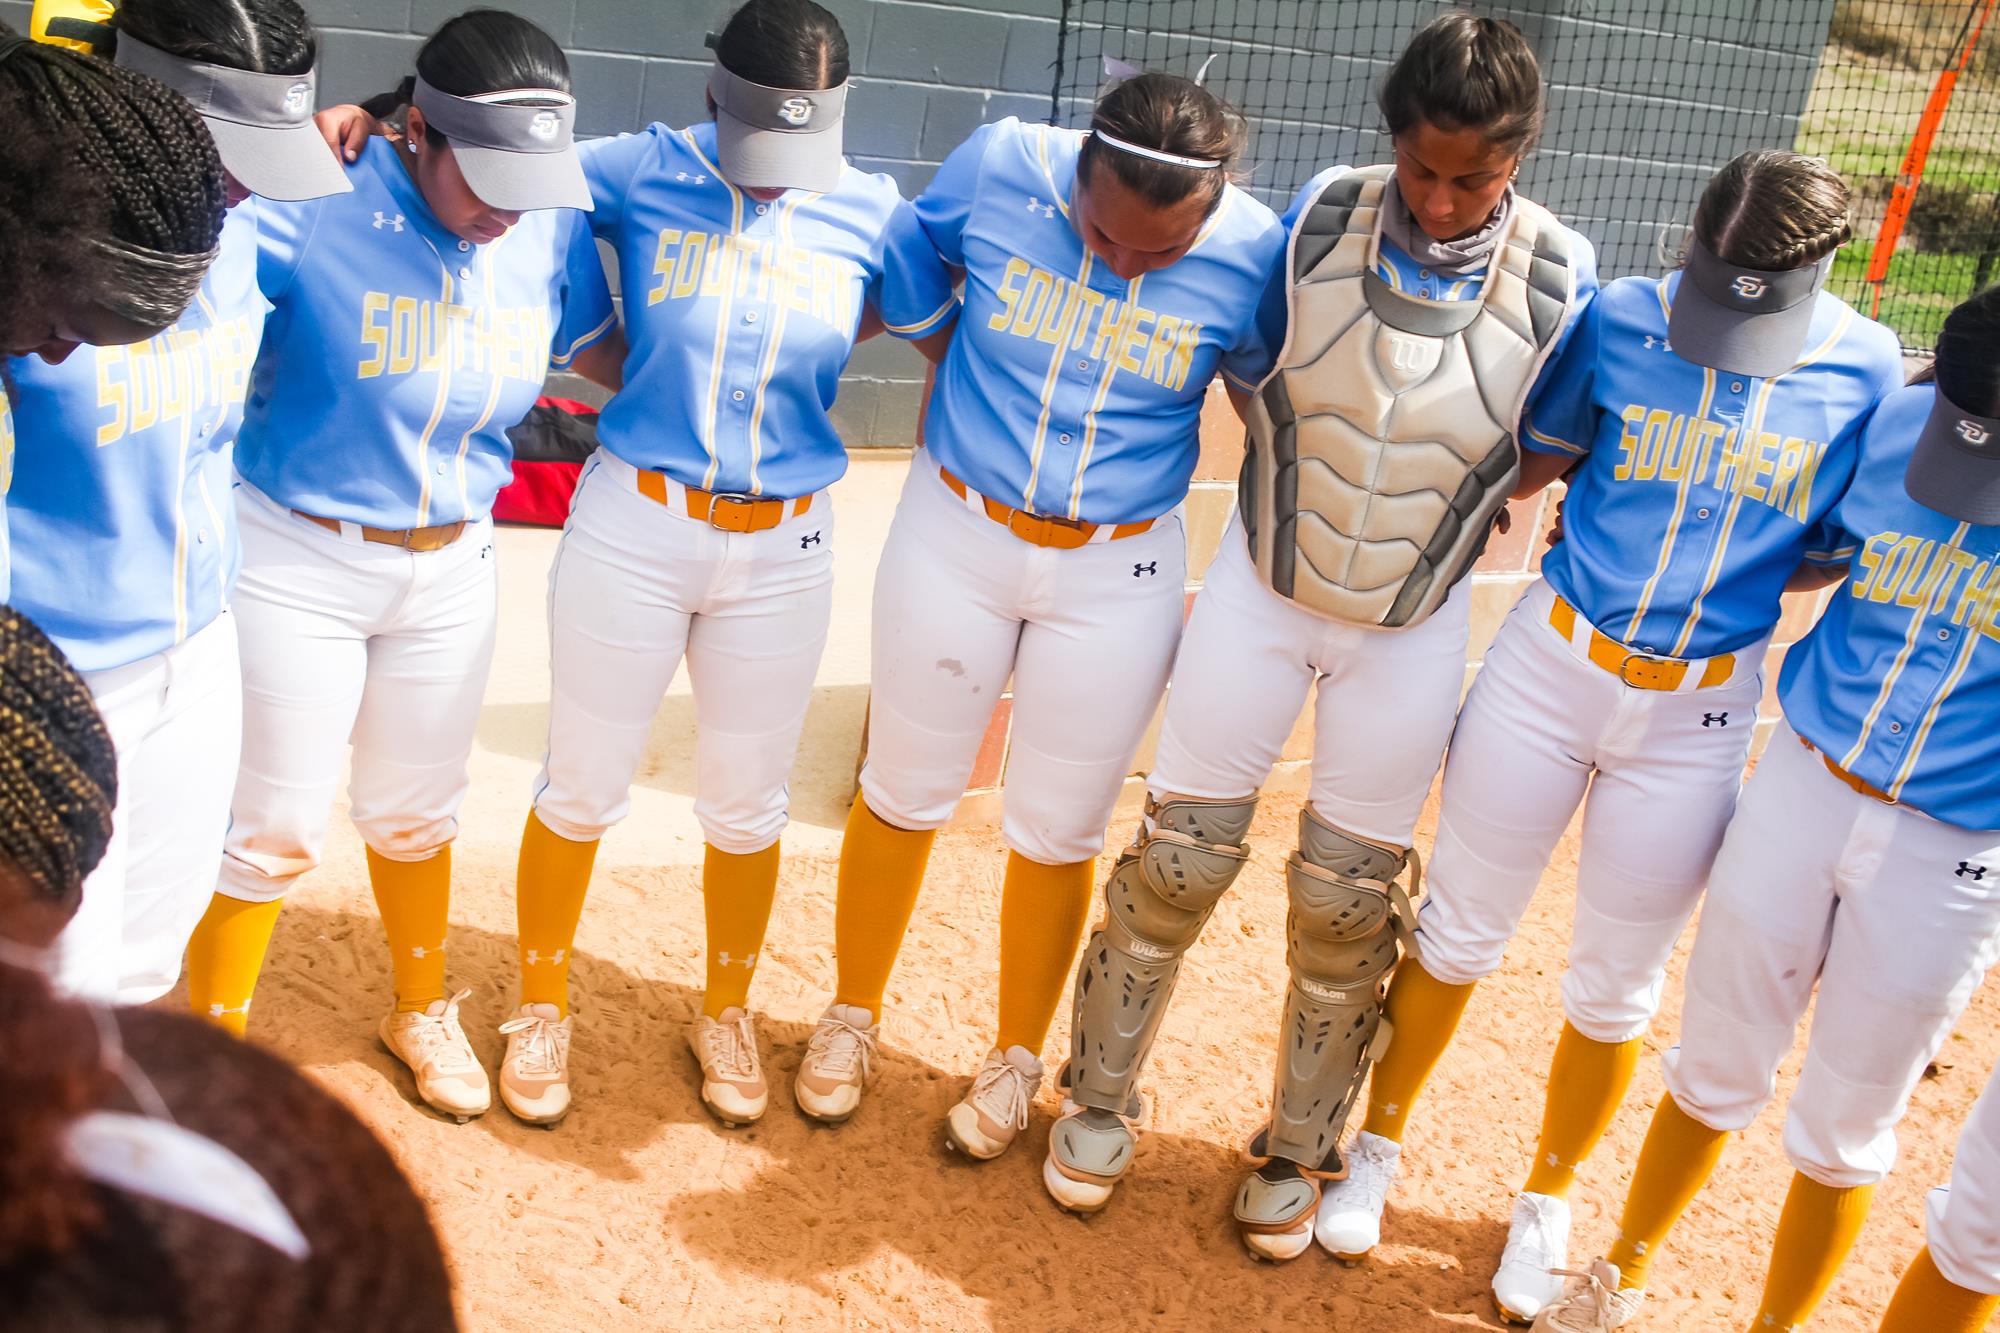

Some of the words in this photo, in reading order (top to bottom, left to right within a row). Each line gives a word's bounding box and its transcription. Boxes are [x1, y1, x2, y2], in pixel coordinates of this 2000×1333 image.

[648, 228, 851, 339] SOUTHERN
[1731, 276, 1768, 298] SU
[988, 256, 1204, 392] SOUTHERN
[1956, 420, 1990, 444] SU
[1614, 404, 1828, 524] SOUTHERN
[1130, 941, 1174, 959] Wilson
[1301, 978, 1346, 1000] Wilson
